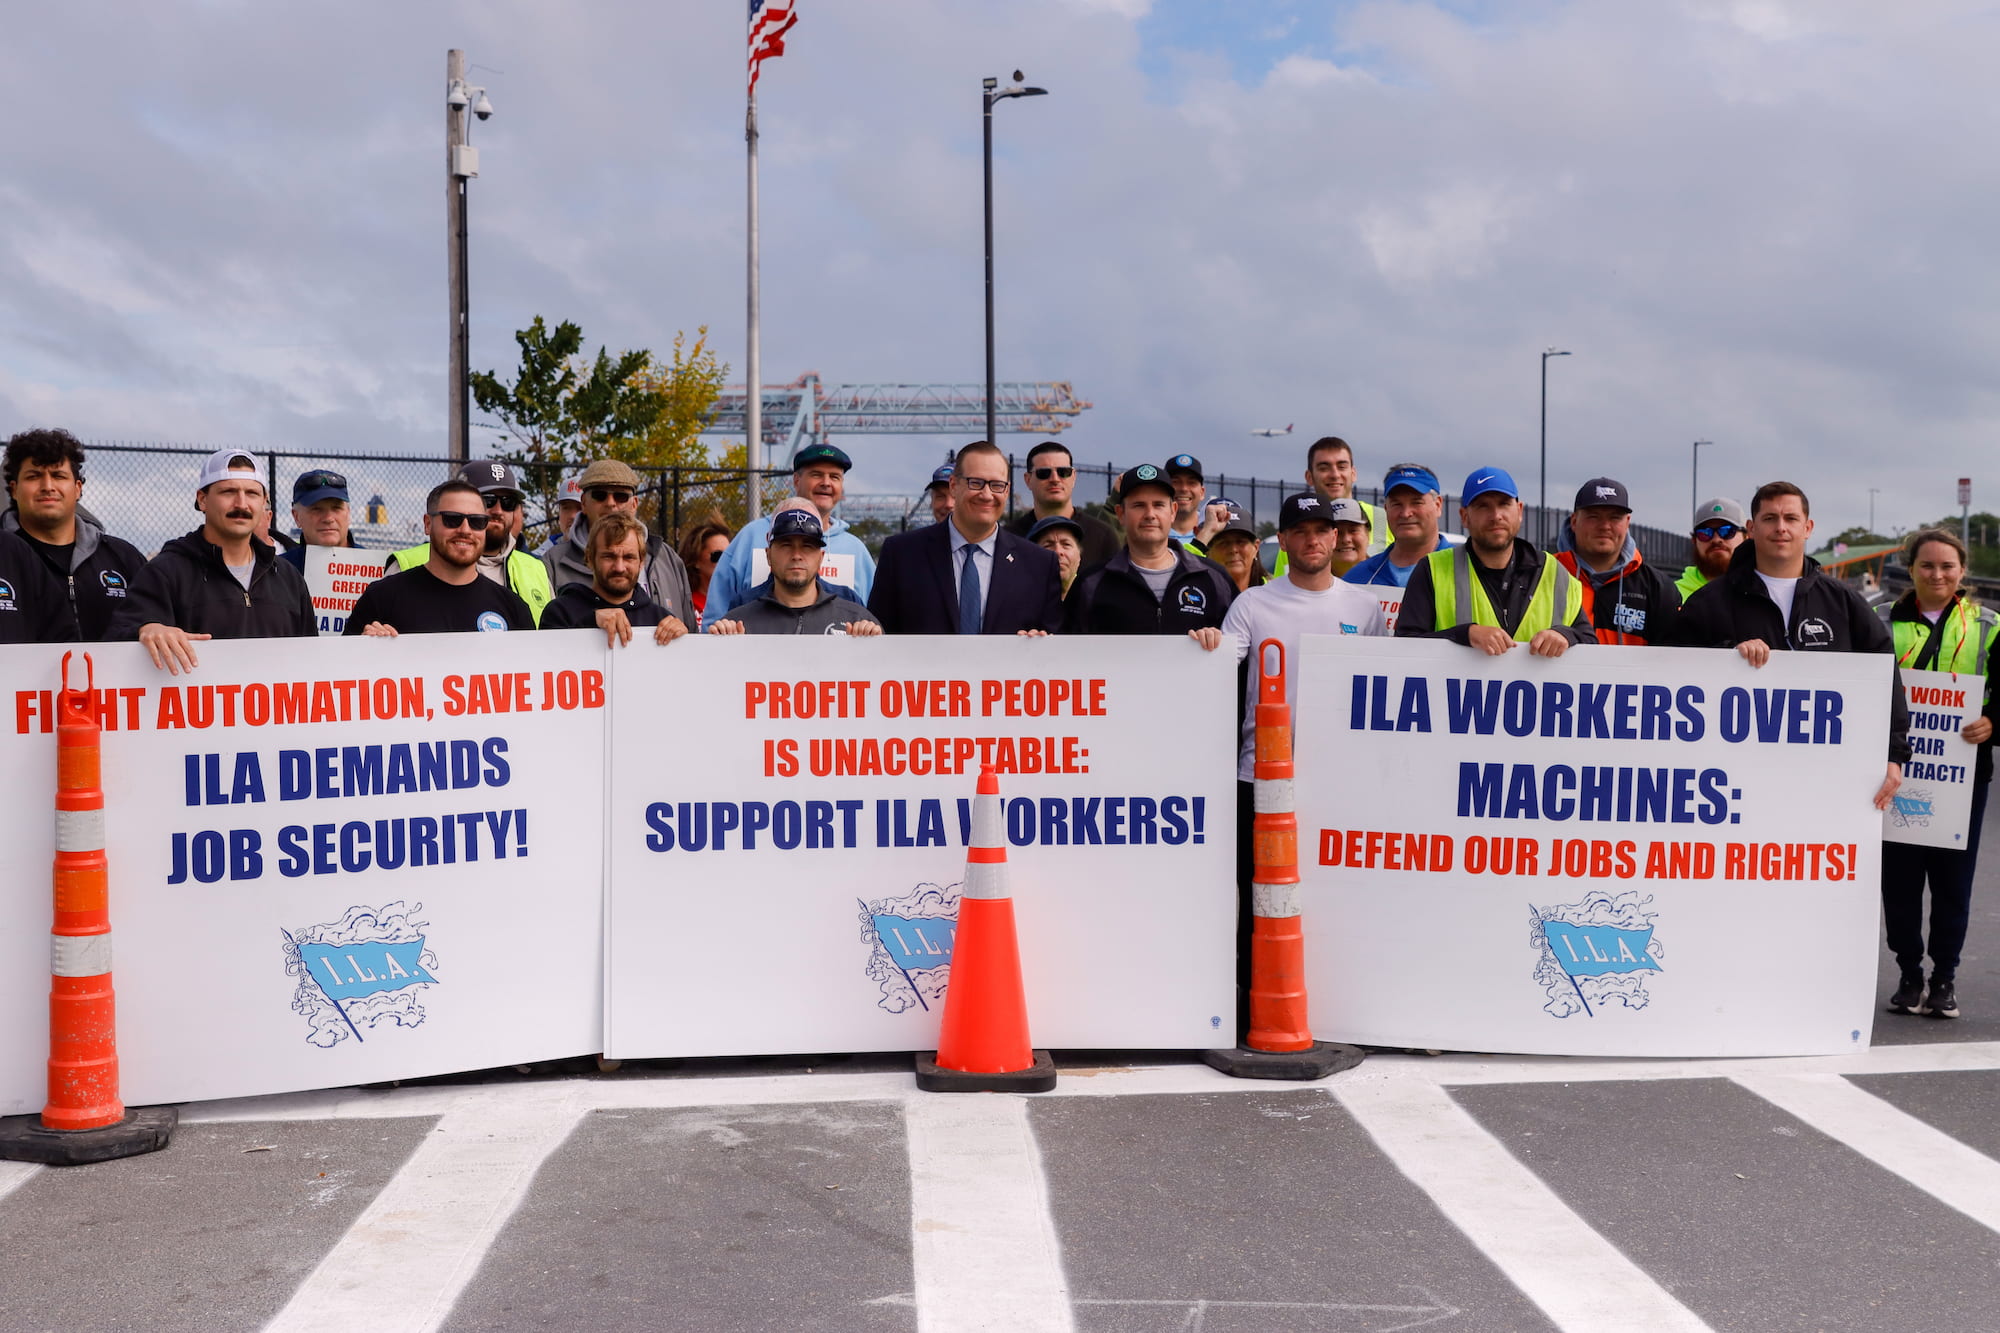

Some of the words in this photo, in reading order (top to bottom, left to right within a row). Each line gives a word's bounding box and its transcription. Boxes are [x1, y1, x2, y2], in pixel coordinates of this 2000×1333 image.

[328, 562, 385, 579] CORPORA
[818, 567, 838, 577] VER
[15, 687, 147, 734] FIHT
[156, 676, 435, 730] AUTOMATION,
[443, 672, 533, 717] SAVE
[542, 669, 606, 711] JOB
[745, 680, 871, 720] PROFIT
[880, 679, 972, 719] OVER
[981, 679, 1108, 718] PEOPLE
[1350, 674, 1432, 733] ILA
[1446, 678, 1706, 742] WORKERS
[1719, 686, 1844, 745] OVER
[1911, 686, 1966, 708] WORK
[1908, 711, 1963, 733] THOUT
[763, 738, 800, 778] IS
[810, 736, 1090, 777] UNACCEPTABLE:
[1907, 736, 1945, 756] FAIR
[185, 752, 266, 807] ILA
[279, 736, 511, 802] DEMANDS
[1904, 761, 1966, 783] TRACT!
[1457, 761, 1742, 825] MACHINES:
[645, 799, 864, 853] SUPPORT
[877, 798, 947, 848] ILA
[167, 829, 263, 885] JOB
[278, 808, 528, 878] SECURITY!
[1318, 828, 1454, 873] DEFEND
[1463, 835, 1540, 876] OUR
[1547, 838, 1637, 880] JOBS
[1643, 840, 1716, 880] AND
[1724, 842, 1857, 882] RIGHTS!
[890, 927, 958, 956] I.L.
[1560, 934, 1647, 963] I.L.A.
[320, 952, 420, 986] I.L.A.
